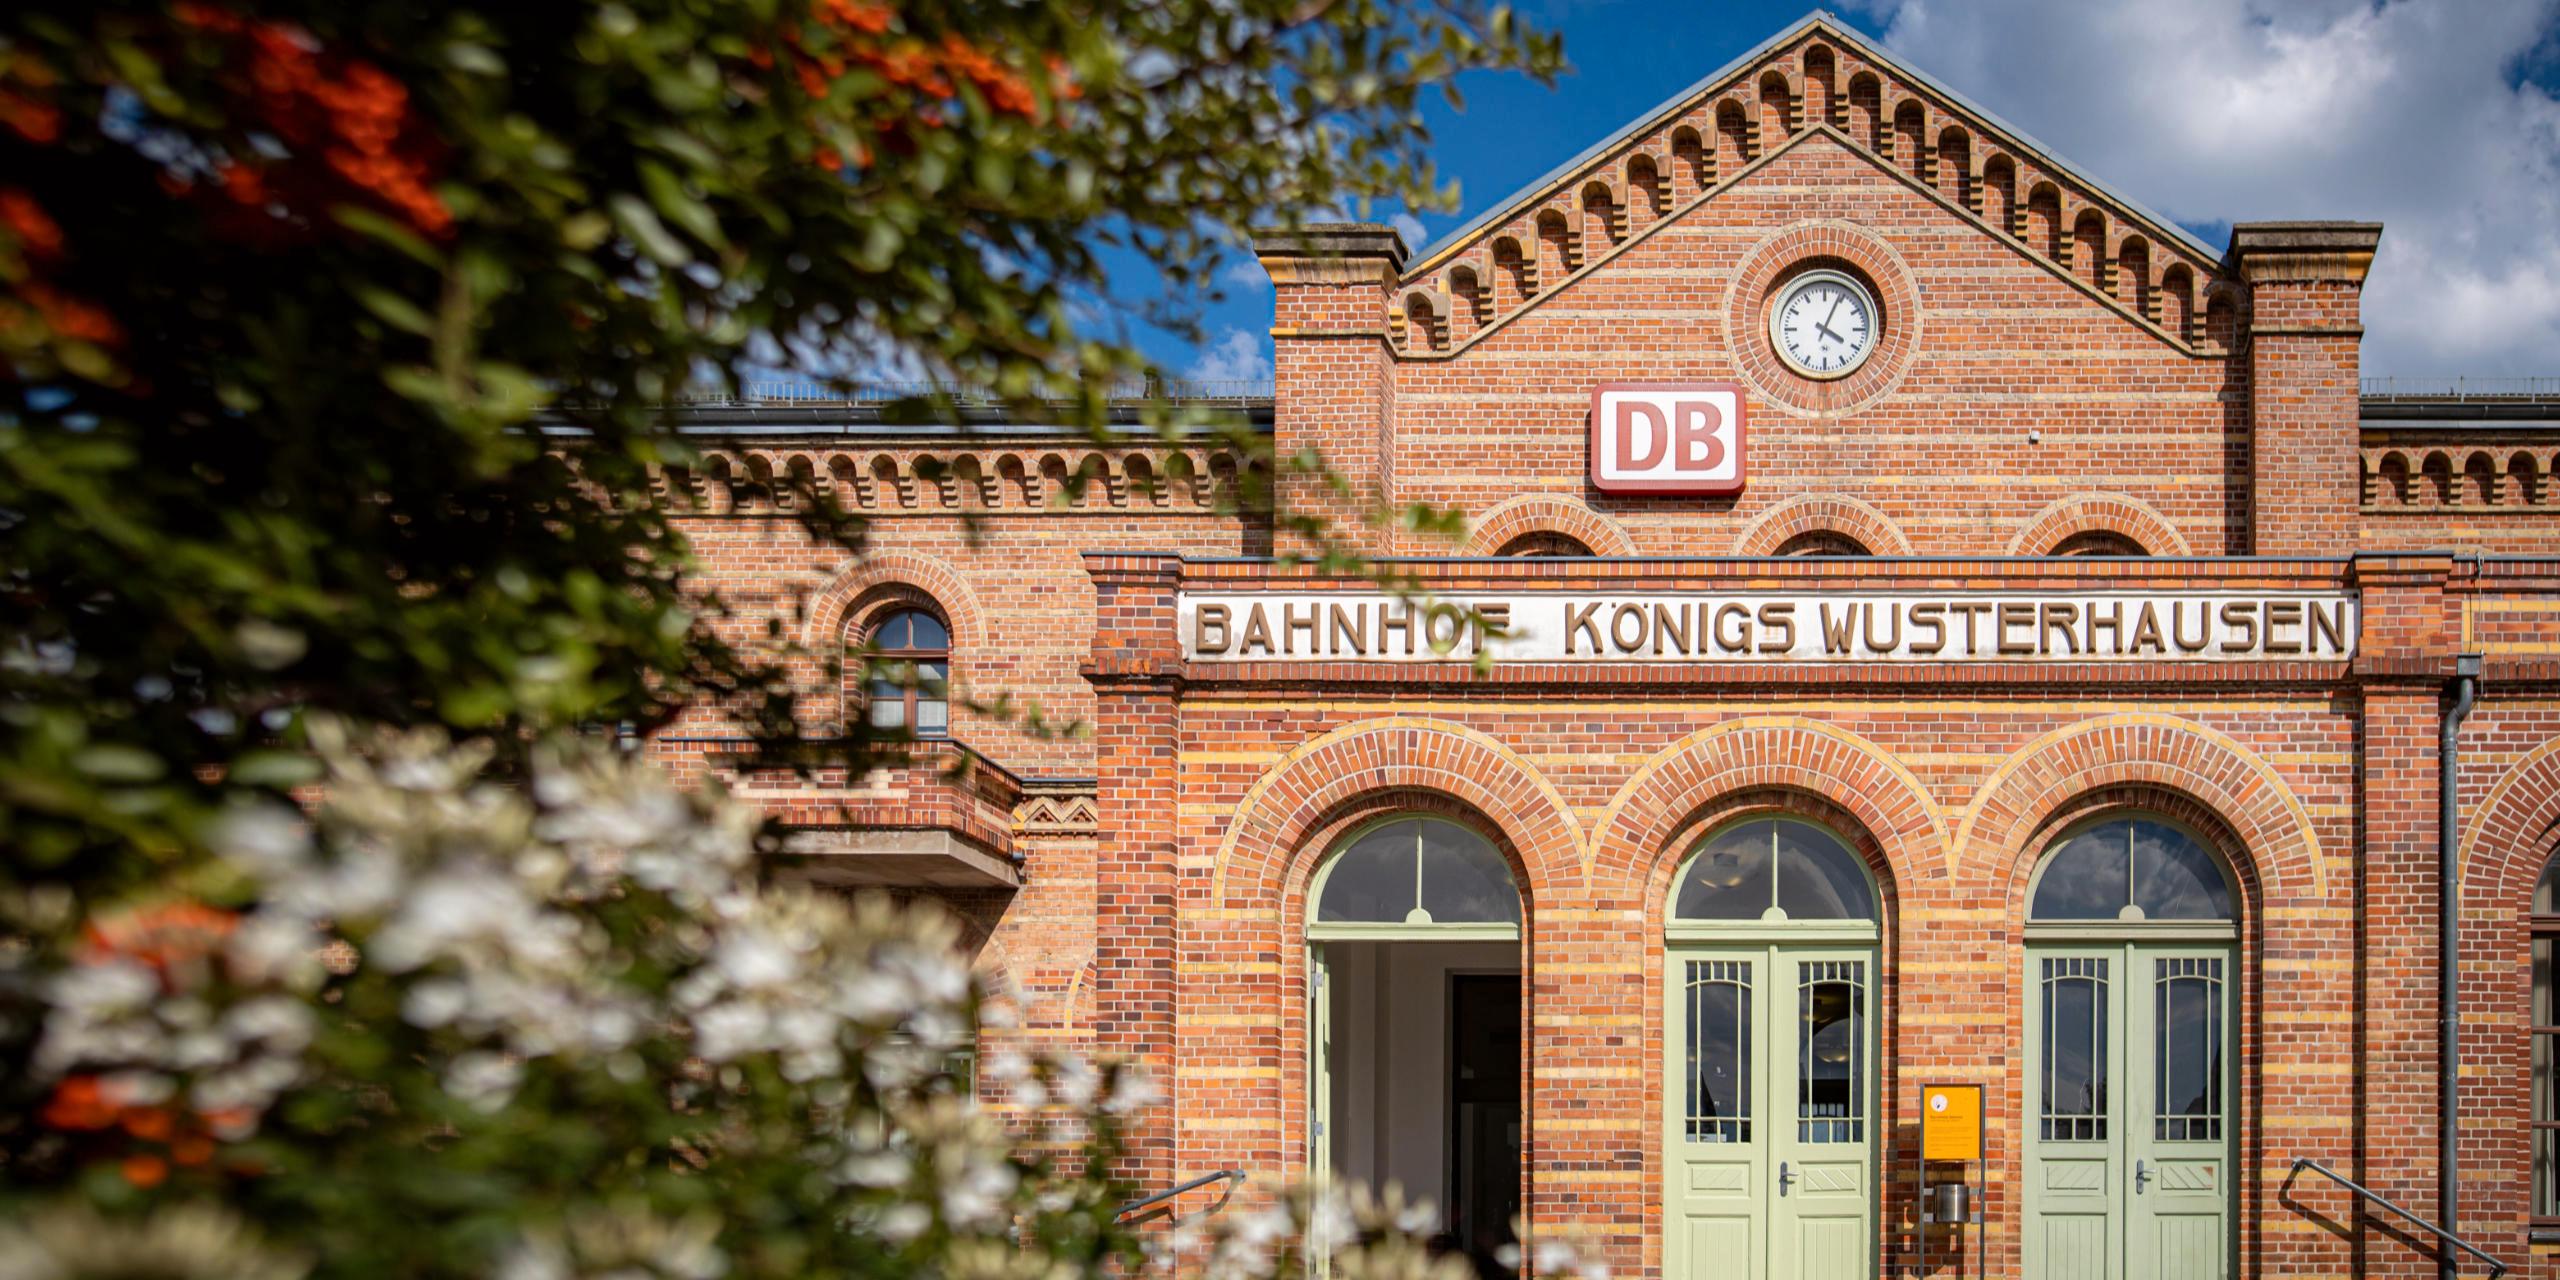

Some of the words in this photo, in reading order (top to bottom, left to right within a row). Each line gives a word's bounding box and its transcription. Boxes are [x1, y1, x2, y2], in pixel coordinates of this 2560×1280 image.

[1616, 401, 1725, 471] DB
[1195, 602, 1510, 655] BAHNHOF
[1565, 601, 1796, 655] KÖNIGS
[1820, 601, 2345, 655] WUSTERHAUSEN
